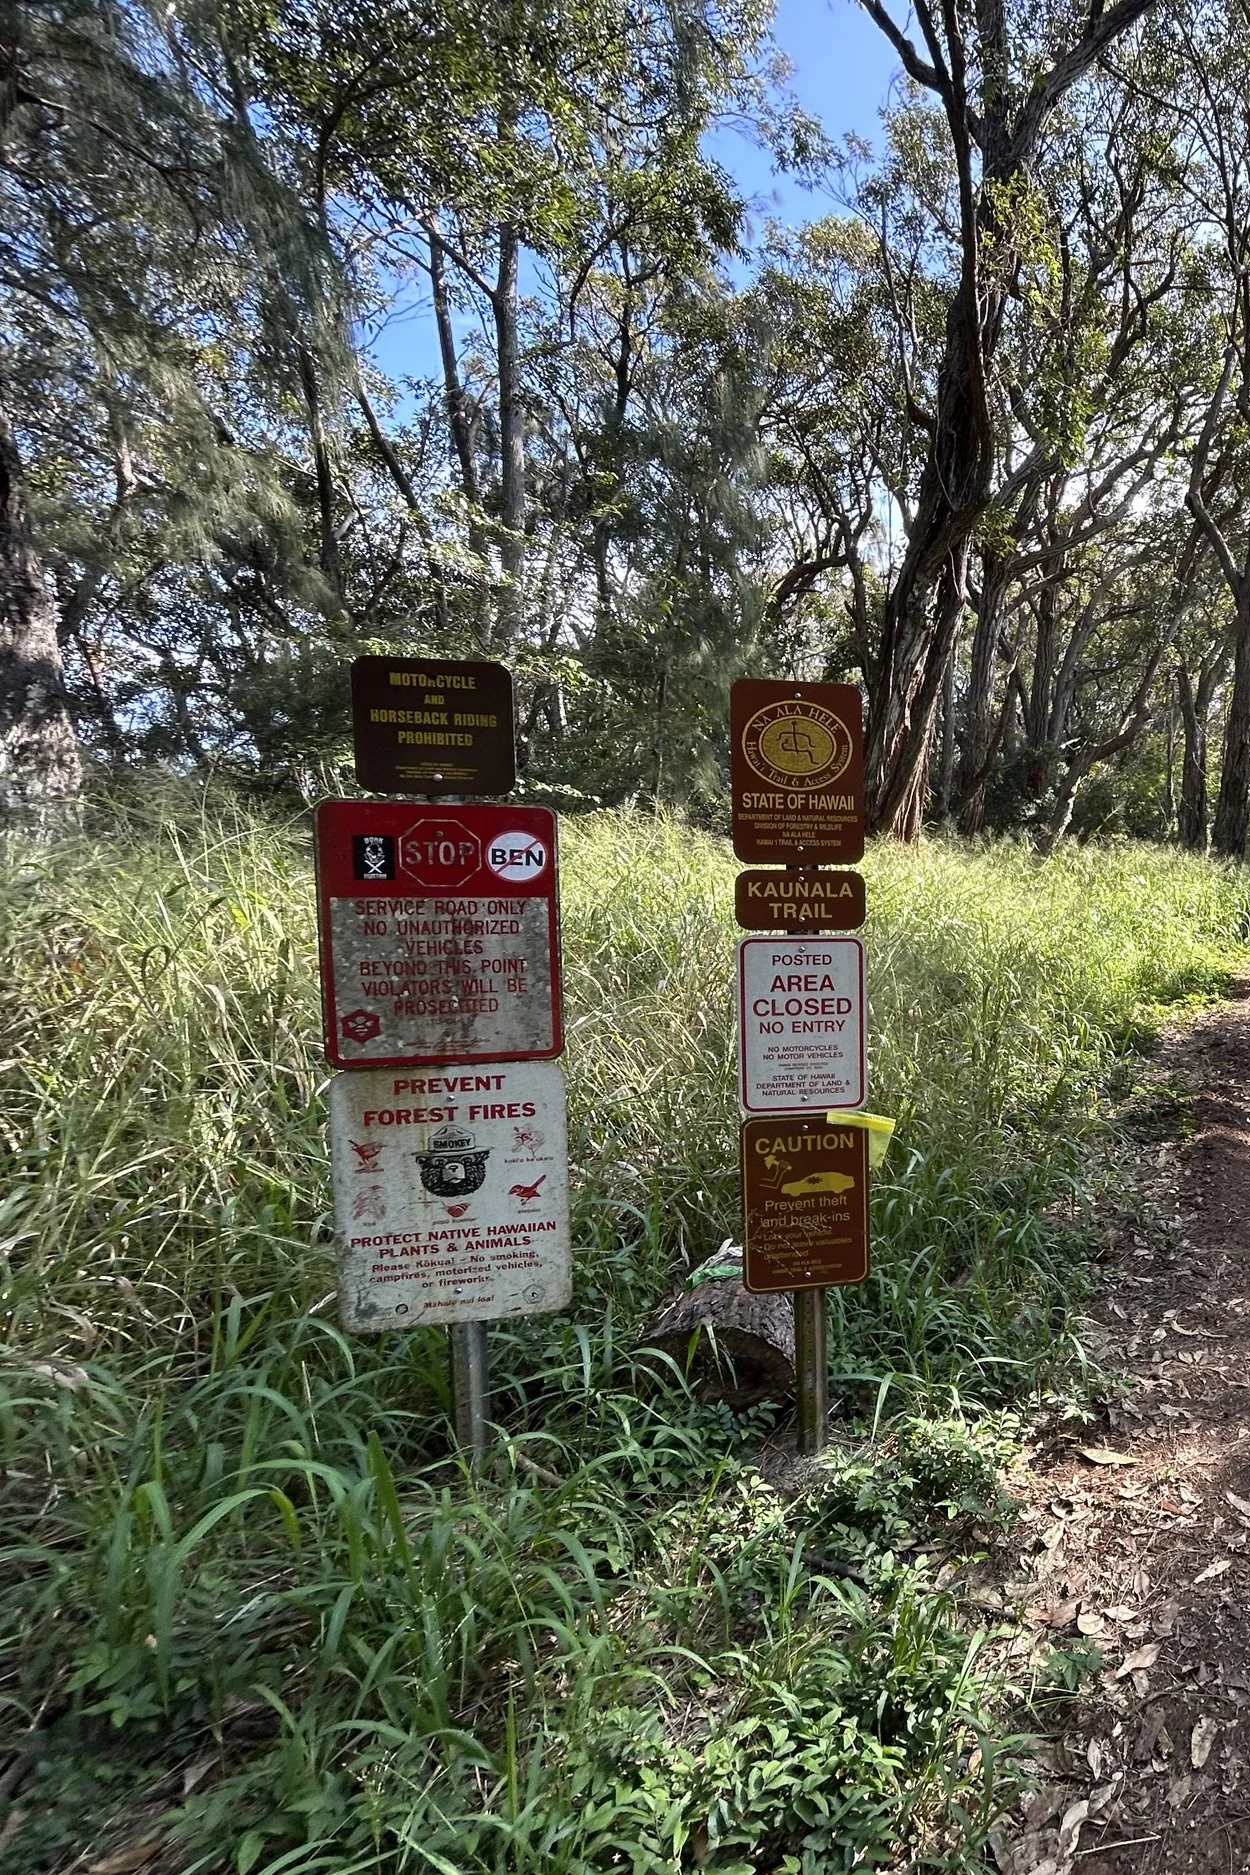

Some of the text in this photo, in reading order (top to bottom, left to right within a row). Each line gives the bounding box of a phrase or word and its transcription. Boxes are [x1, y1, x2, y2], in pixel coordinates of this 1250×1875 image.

[424, 694, 444, 705] AND
[370, 709, 497, 727] HORSEBACK RIDING
[752, 704, 842, 734] NA ALA HELE
[398, 731, 473, 746] PROHIBITED
[768, 769, 788, 785] Trail
[791, 777, 799, 786] &
[804, 773, 832, 787] Access
[831, 744, 848, 773] System
[742, 792, 854, 810] STATE OF HAWAII
[405, 841, 474, 865] STOP
[491, 848, 543, 867] BEN
[747, 882, 853, 898] KAUNALA
[356, 900, 526, 915] SERVICE ROAD ONLY
[769, 903, 833, 919] TRAIL
[364, 919, 520, 936] NO UNAUTHORIZED
[405, 940, 483, 955] VEHICLES
[360, 959, 527, 976] BEYOND THIS POINT
[772, 954, 832, 966] POSTED
[362, 978, 527, 996] VIOLATORS WILL BE
[770, 974, 835, 992] AREA
[752, 998, 852, 1016] CLOSED
[760, 1020, 846, 1034] NO ENTRY
[782, 1044, 838, 1052] MOTORCYCLES
[394, 1075, 505, 1095] PREVENT
[799, 1087, 845, 1095] RESOURCES
[364, 1102, 536, 1127] FOREST FIRES
[433, 1138, 471, 1149] SMOKEY
[755, 1132, 854, 1154] CAUTION
[765, 1195, 848, 1211] Prevent theft
[762, 1212, 851, 1228] and break-ins
[351, 1232, 422, 1248] PROTECT
[428, 1227, 480, 1241] NATIVE
[487, 1220, 557, 1236] HAWAIIAN
[379, 1236, 532, 1259] PLANTS & ANIMALS
[371, 1262, 411, 1272] Please
[470, 1255, 485, 1263] No
[435, 1265, 491, 1277] motorized
